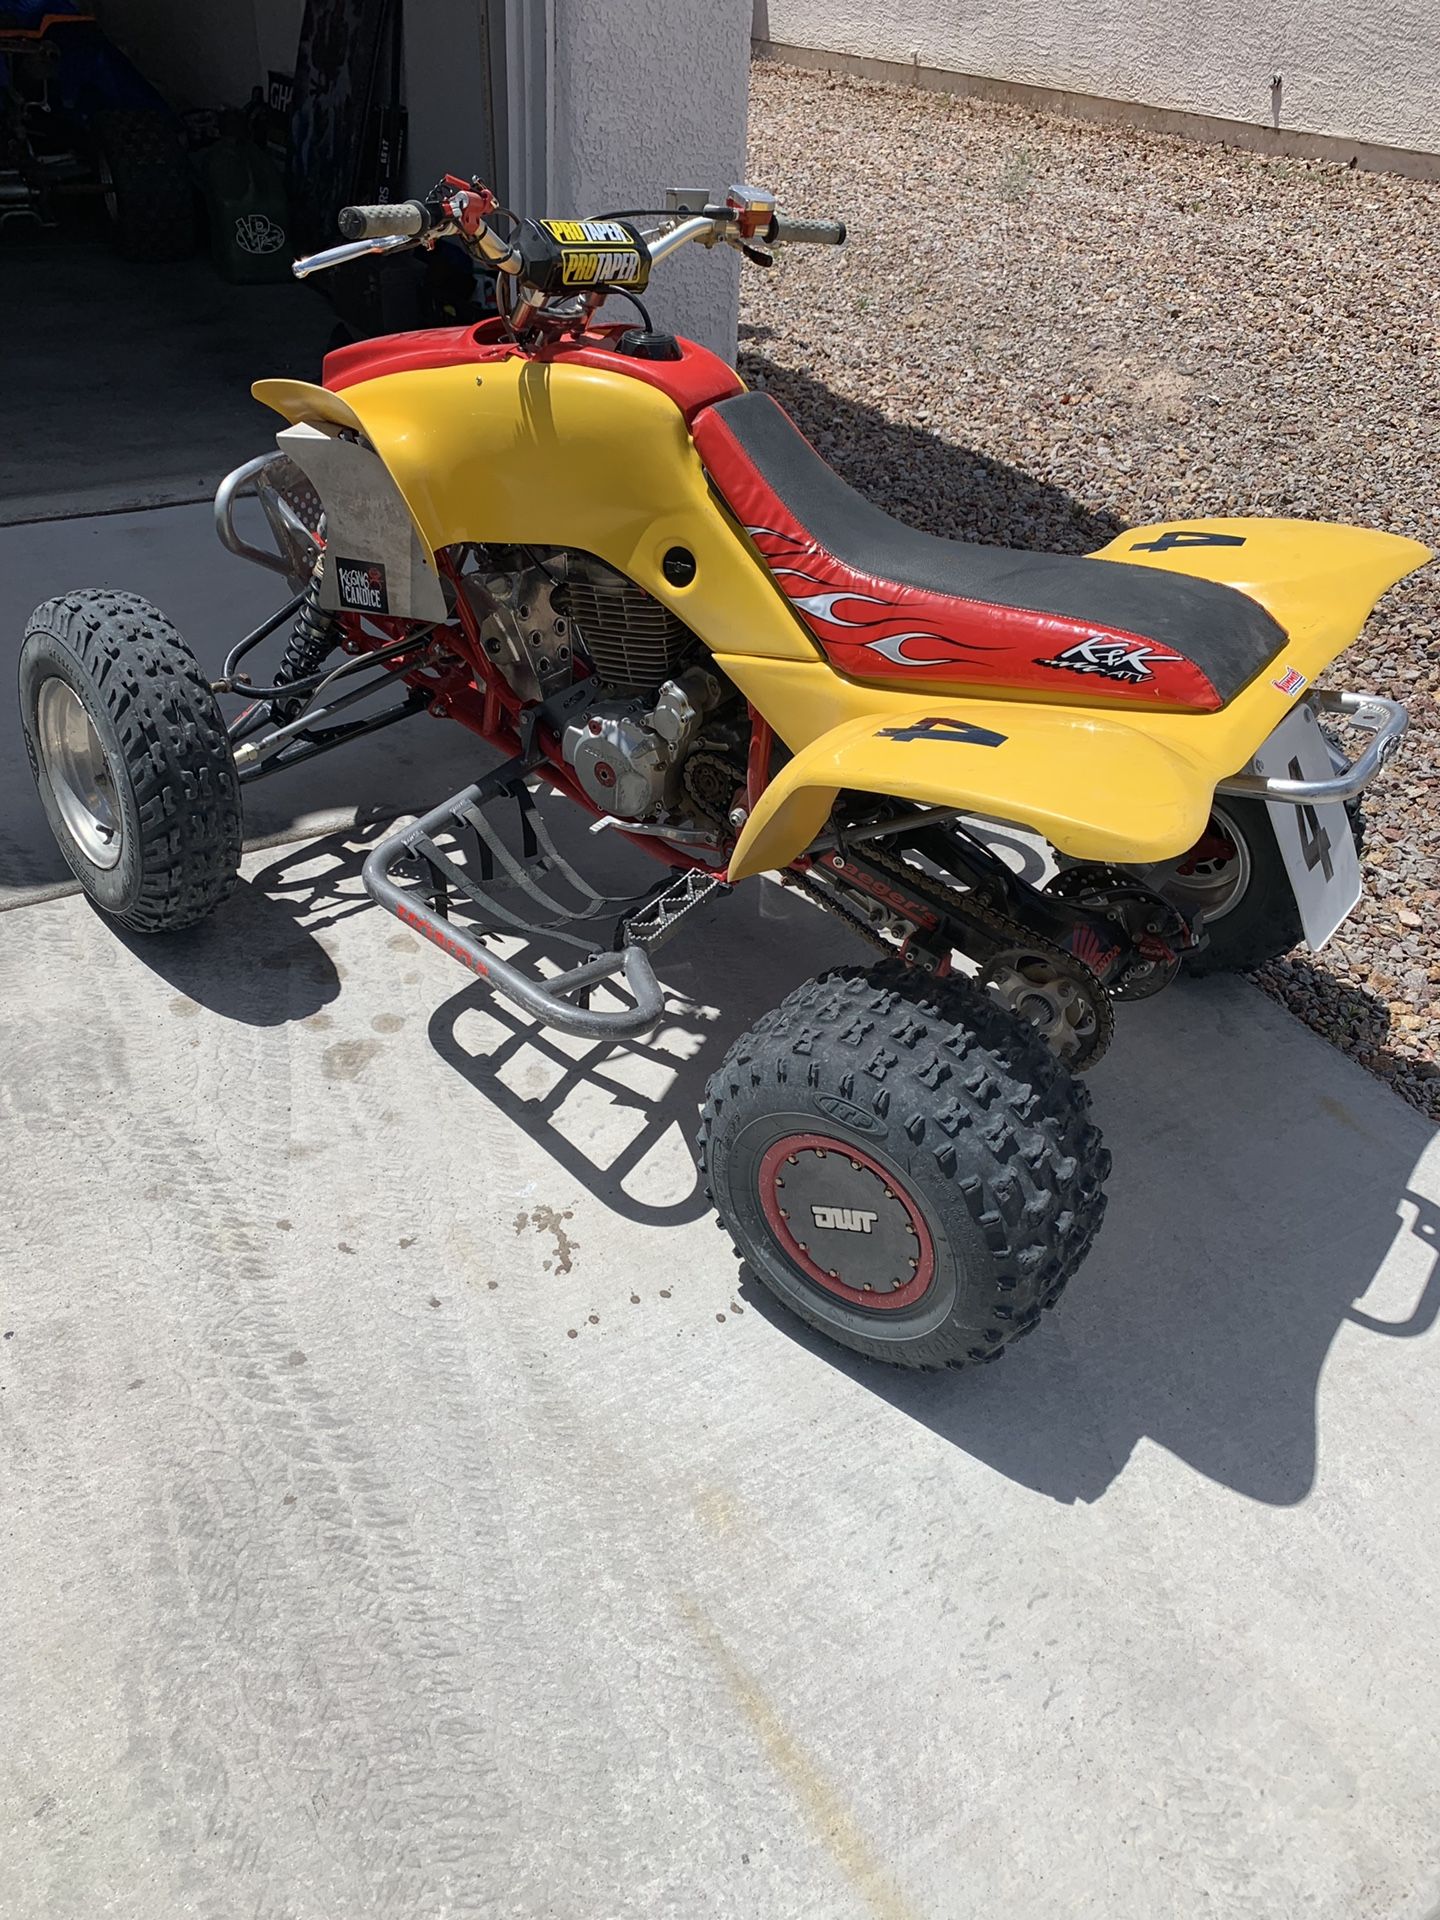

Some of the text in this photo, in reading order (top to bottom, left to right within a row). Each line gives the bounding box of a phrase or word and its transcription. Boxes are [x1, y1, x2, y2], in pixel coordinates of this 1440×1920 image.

[1129, 531, 1247, 553] 4
[344, 585, 382, 608] CANDICE
[872, 717, 1009, 748] 4
[1288, 755, 1335, 883] 4
[1093, 944, 1122, 975] ONDA
